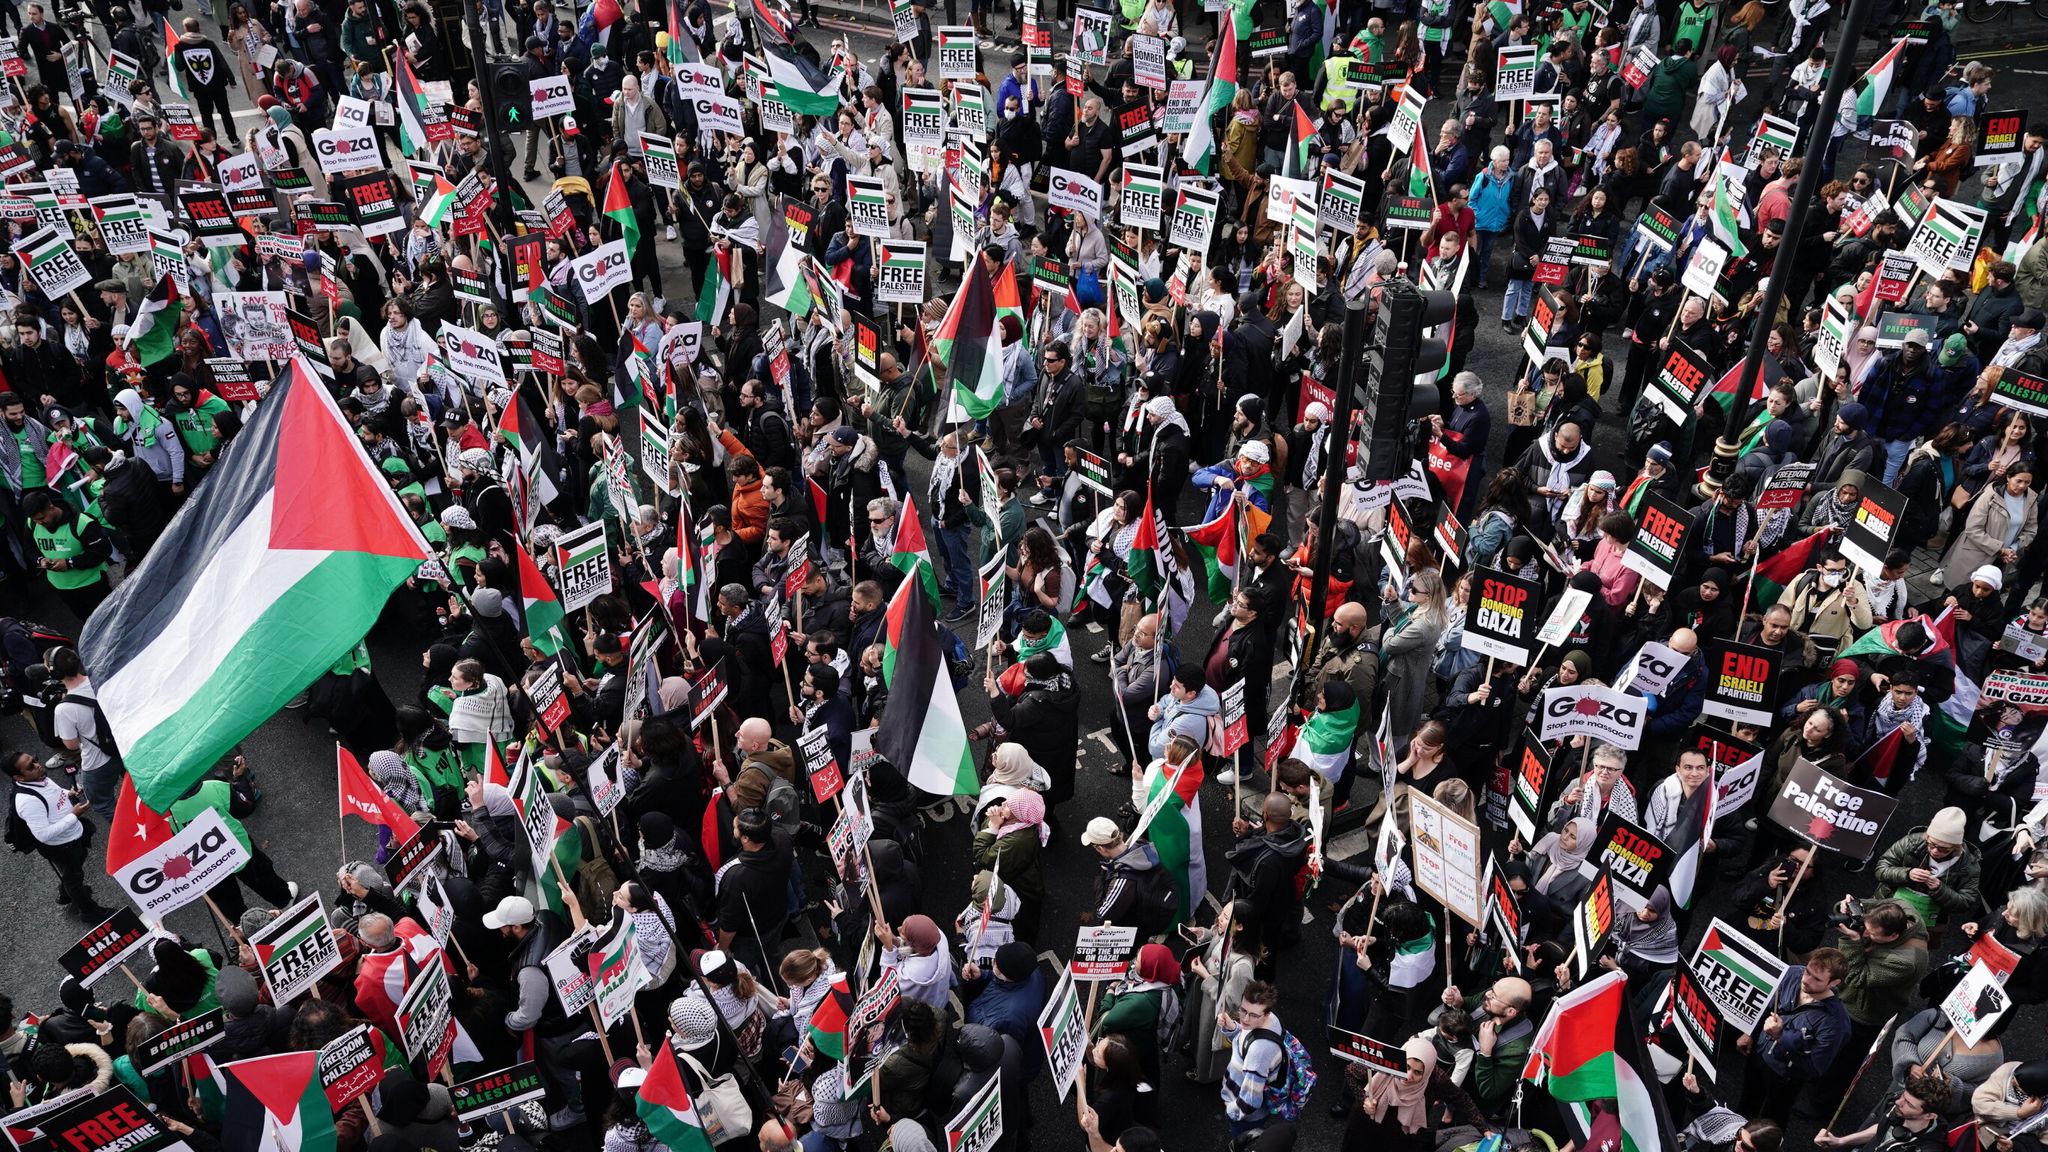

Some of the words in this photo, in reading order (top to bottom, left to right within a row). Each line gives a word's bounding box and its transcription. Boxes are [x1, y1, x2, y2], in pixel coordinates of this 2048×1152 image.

[894, 13, 914, 28] FREE
[1253, 36, 1286, 48] PALESTINE
[940, 50, 974, 62] FREE
[1072, 50, 1104, 64] PALESTINE
[1134, 50, 1164, 64] BOMBED
[941, 61, 974, 70] PALESTINE
[1349, 73, 1382, 81] PALESTINE
[1500, 70, 1532, 83] FREE
[1498, 81, 1532, 91] PALESTINE
[905, 112, 940, 127] FREE
[958, 108, 983, 123] FREE
[1120, 107, 1148, 123] FREE
[905, 125, 940, 134] PALESTINE
[1122, 121, 1151, 138] PALESTINE
[1889, 123, 1913, 140] Free
[1988, 118, 2019, 134] END
[1984, 140, 2016, 148] APARTHEID
[1987, 133, 2016, 143] ISRAELI
[348, 154, 376, 162] massacre
[646, 158, 675, 176] FREE
[237, 195, 266, 204] ISRAELI
[354, 182, 390, 204] FREE
[1124, 191, 1160, 207] FREE
[5, 210, 34, 218] GAZA
[188, 198, 224, 220] FREE
[358, 199, 394, 213] PALESTINE
[786, 205, 812, 222] STOP
[852, 203, 886, 218] FREE
[1124, 205, 1160, 217] PALESTINE
[1390, 208, 1430, 217] PALESTINE
[196, 215, 232, 228] PALESTINE
[853, 215, 887, 226] PALESTINE
[1642, 214, 1678, 241] PALESTINE
[1655, 212, 1672, 228] FREE
[101, 218, 146, 240] FREE
[106, 232, 149, 244] PALESTINE
[1916, 227, 1951, 255] FREE
[262, 246, 274, 254] IN
[276, 248, 302, 260] GAZA
[1542, 253, 1570, 263] PALESTINE
[1548, 244, 1573, 256] FREEDOM
[1912, 239, 1947, 265] PALESTINE
[33, 253, 78, 282] FREE
[1884, 259, 1913, 269] FREEDOM
[48, 262, 85, 290] PALESTINE
[881, 268, 922, 282] FREE
[1036, 266, 1069, 284] PALESTINE
[881, 282, 922, 290] PALESTINE
[242, 297, 267, 305] SAVE
[534, 333, 560, 348] FREEDOM
[858, 323, 876, 343] END
[533, 343, 561, 358] PALESTINE
[211, 364, 244, 372] FREEDOM
[1665, 351, 1704, 390] FREE
[214, 374, 250, 382] PALESTINE
[1660, 368, 1695, 404] PALESTINE
[2017, 376, 2043, 390] FREE
[1308, 383, 1331, 402] Unite
[1775, 470, 1810, 478] FREEDOM
[1768, 481, 1806, 490] PALESTINE
[1359, 495, 1376, 504] Stop
[1378, 490, 1389, 498] the
[1642, 506, 1684, 548] FREE
[1856, 508, 1868, 523] ON
[1866, 514, 1890, 541] ISRAEL
[1637, 529, 1673, 561] PALESTINE
[562, 553, 608, 588] FREE
[564, 570, 609, 599] PALESTINE
[1483, 579, 1528, 608] STOP
[1480, 597, 1524, 620] BOMBING
[1477, 608, 1522, 638] GAZA
[1722, 652, 1770, 682] END
[1720, 675, 1764, 694] ISRAELI
[1990, 675, 2017, 684] STOP
[1717, 686, 1762, 702] APARTHEID
[1986, 688, 2004, 698] IN
[1547, 721, 1566, 730] Stop
[1569, 720, 1584, 728] the
[1588, 722, 1634, 741] massacre
[1698, 737, 1750, 766] FREE
[1814, 776, 1864, 810] Free
[348, 794, 381, 814] VATA
[1783, 782, 1878, 835] Palestine
[526, 786, 546, 844] FREE
[1612, 826, 1662, 862] STOP
[402, 841, 424, 866] GAZA
[1419, 852, 1440, 872] STOP
[1607, 841, 1654, 874] BOMBING
[147, 893, 171, 912] Stop
[171, 882, 190, 897] the
[191, 848, 237, 887] massacre
[80, 922, 114, 949] STOP
[87, 931, 121, 957] GAZA
[80, 928, 141, 976] GENOCIDE
[266, 928, 334, 986] FREE
[1077, 947, 1096, 956] STOP
[1114, 947, 1130, 955] WAR
[1098, 954, 1120, 962] GAZA!
[272, 946, 335, 994] PALESTINE
[1695, 957, 1768, 1010] FREE
[864, 988, 899, 1024] GAZA
[1678, 973, 1716, 1039] FREE
[1677, 993, 1714, 1050] PALESTINE
[150, 1021, 214, 1054] BOMBING
[1053, 1006, 1081, 1065] FREE
[321, 1034, 365, 1070] FREEDOM
[1352, 1042, 1384, 1058] GAZA
[323, 1046, 372, 1086] PALESTINE
[456, 1075, 537, 1108] PALESTINE
[476, 1074, 512, 1092] FREE
[2, 1112, 31, 1126] Palestine
[32, 1101, 62, 1116] Solidarity
[62, 1088, 92, 1105] Campaign
[62, 1102, 147, 1147] FREE
